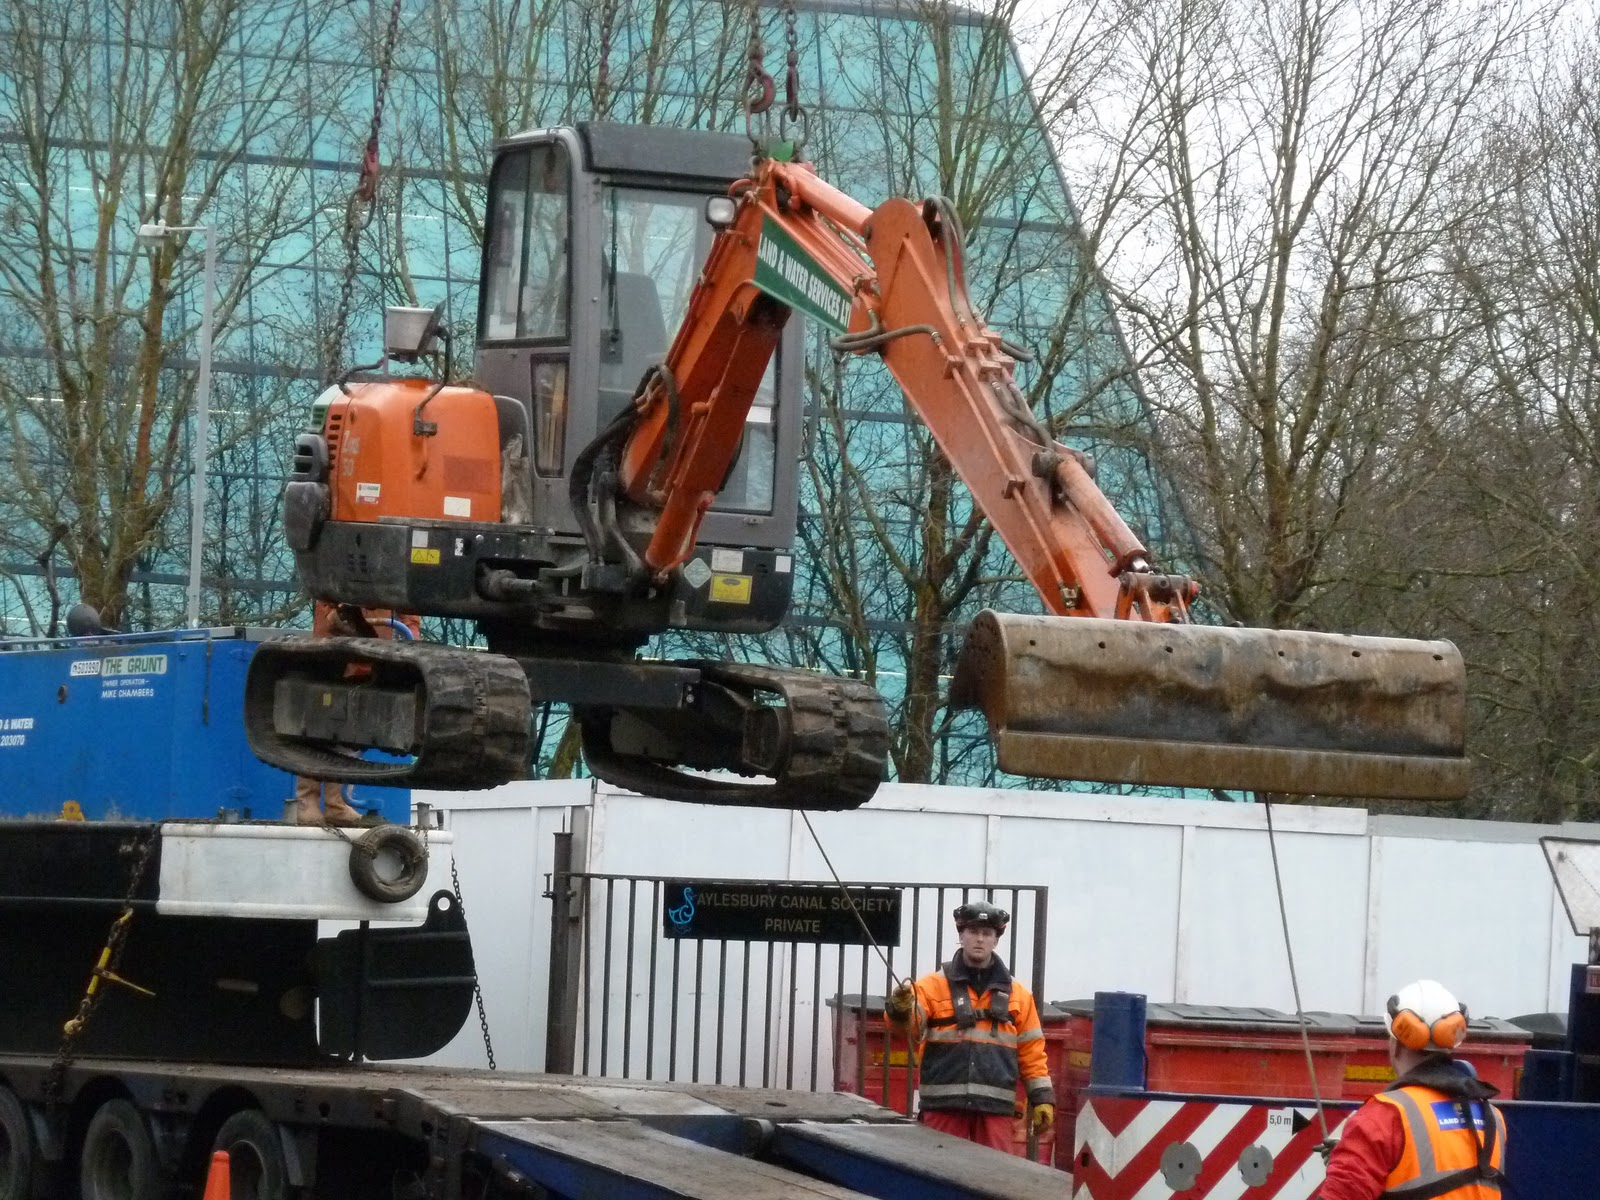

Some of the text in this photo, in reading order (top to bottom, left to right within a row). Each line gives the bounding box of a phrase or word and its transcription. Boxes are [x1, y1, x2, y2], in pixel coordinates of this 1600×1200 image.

[757, 232, 777, 268] LAND
[778, 250, 784, 276] &
[785, 254, 808, 294] WATER
[807, 274, 841, 320] SERVICES
[105, 656, 163, 674] THE GRUNT
[102, 679, 118, 687] OWNER
[102, 688, 154, 698] MIKE CHAMBERS
[3, 718, 9, 730] &
[11, 718, 33, 730] WATER
[697, 891, 894, 913] AYLESBURY CANAL SOCIETY
[765, 917, 821, 933] PRIVATE
[1283, 1117, 1292, 1126] m
[1438, 1117, 1460, 1125] LAND
